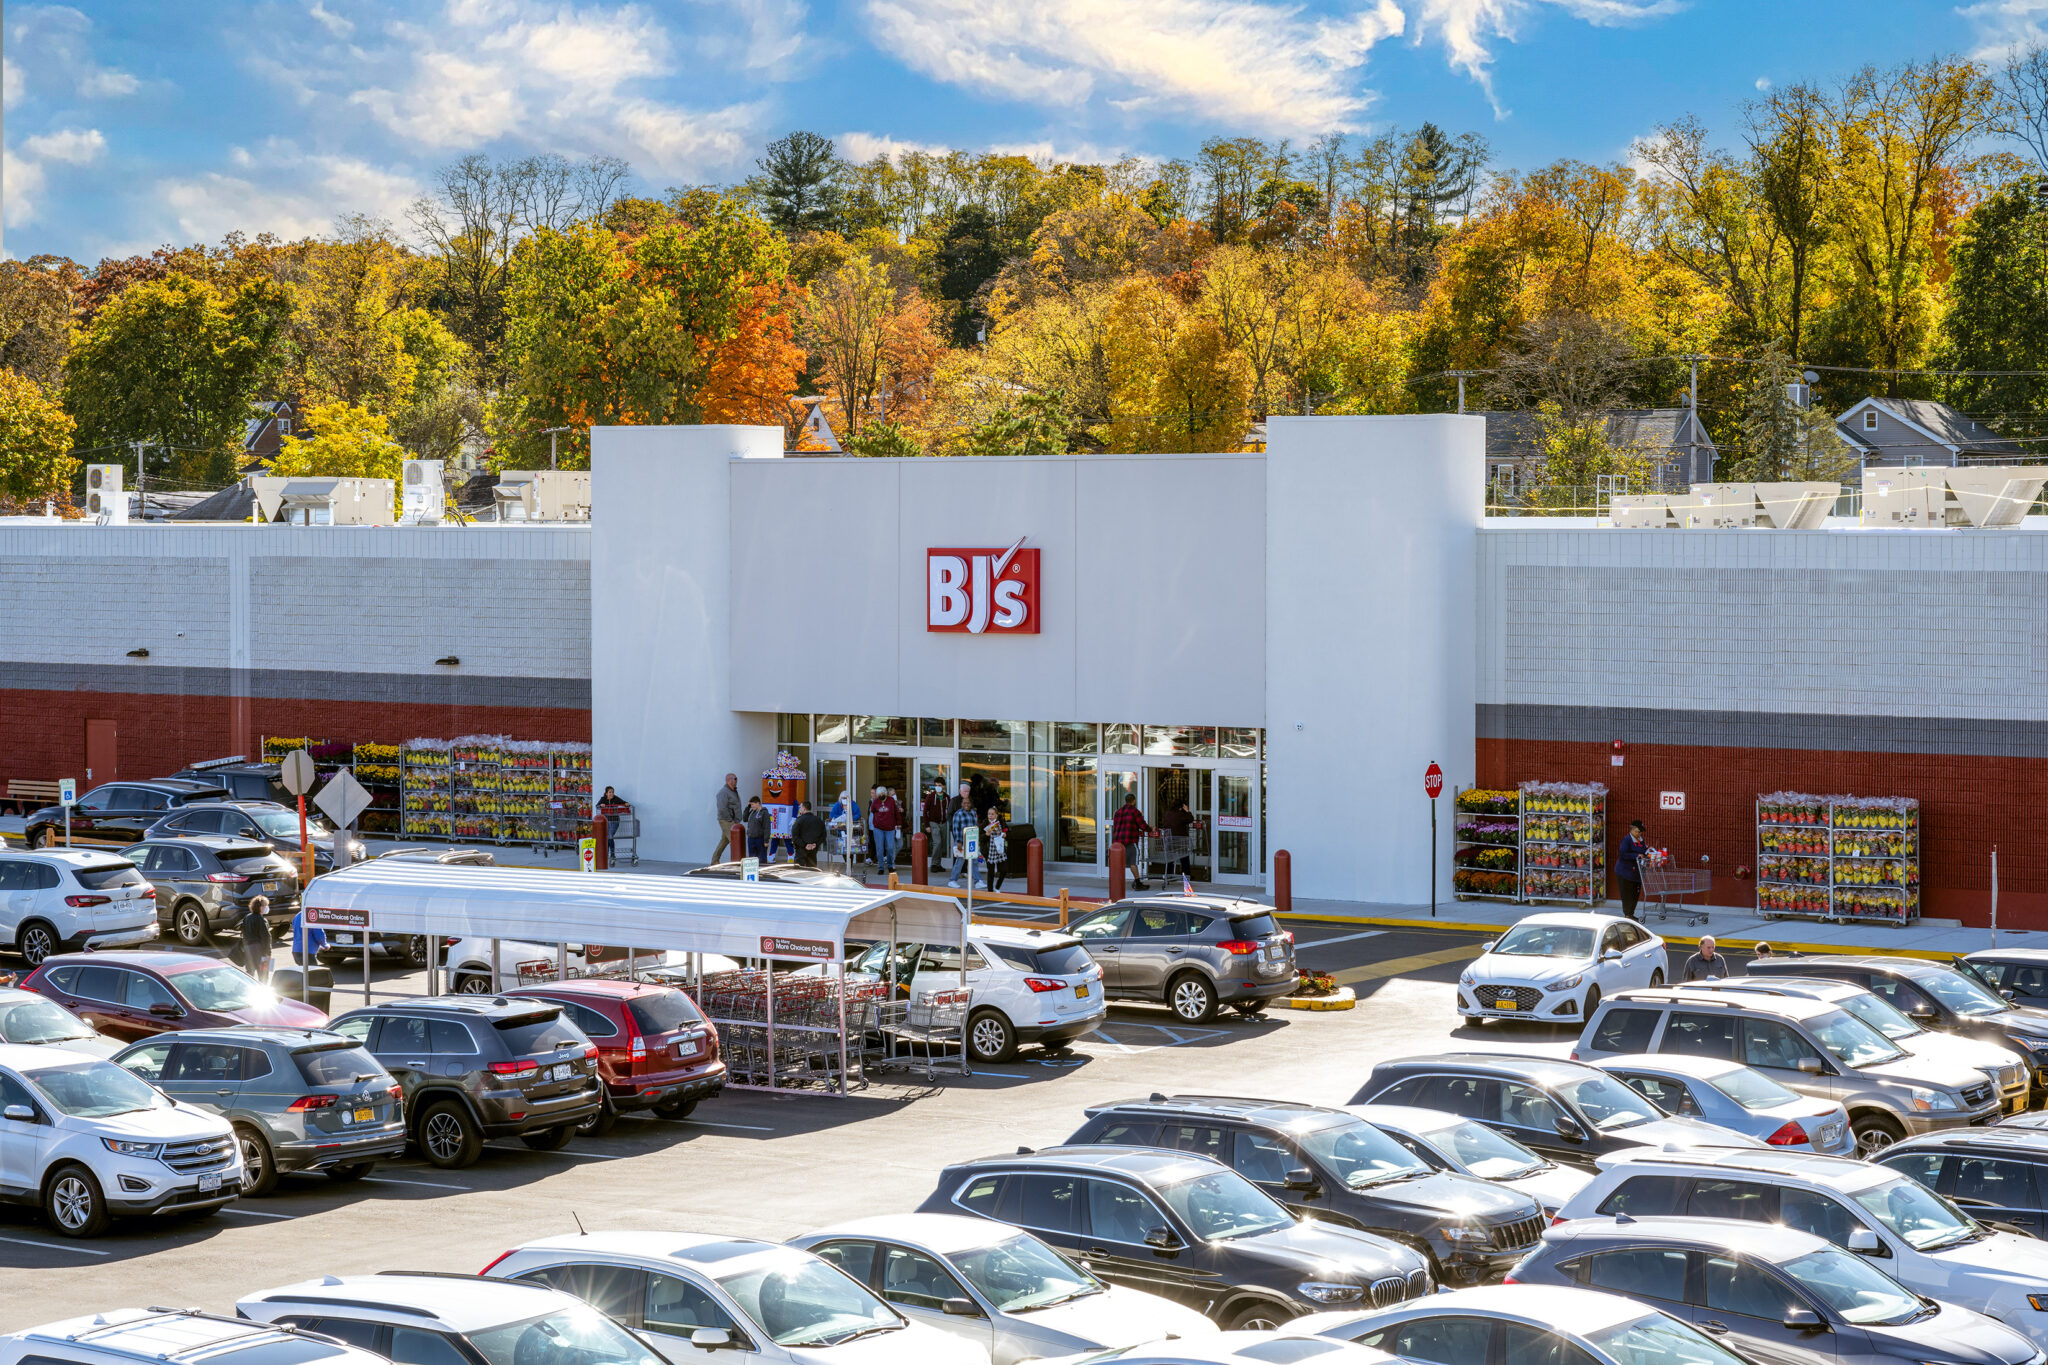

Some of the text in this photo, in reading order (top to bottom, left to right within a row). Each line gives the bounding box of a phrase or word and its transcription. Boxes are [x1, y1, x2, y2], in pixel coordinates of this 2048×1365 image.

[1425, 774, 1441, 788] STOP
[1663, 796, 1682, 805] FDC
[789, 944, 811, 952] Choices
[811, 945, 829, 953] Online
